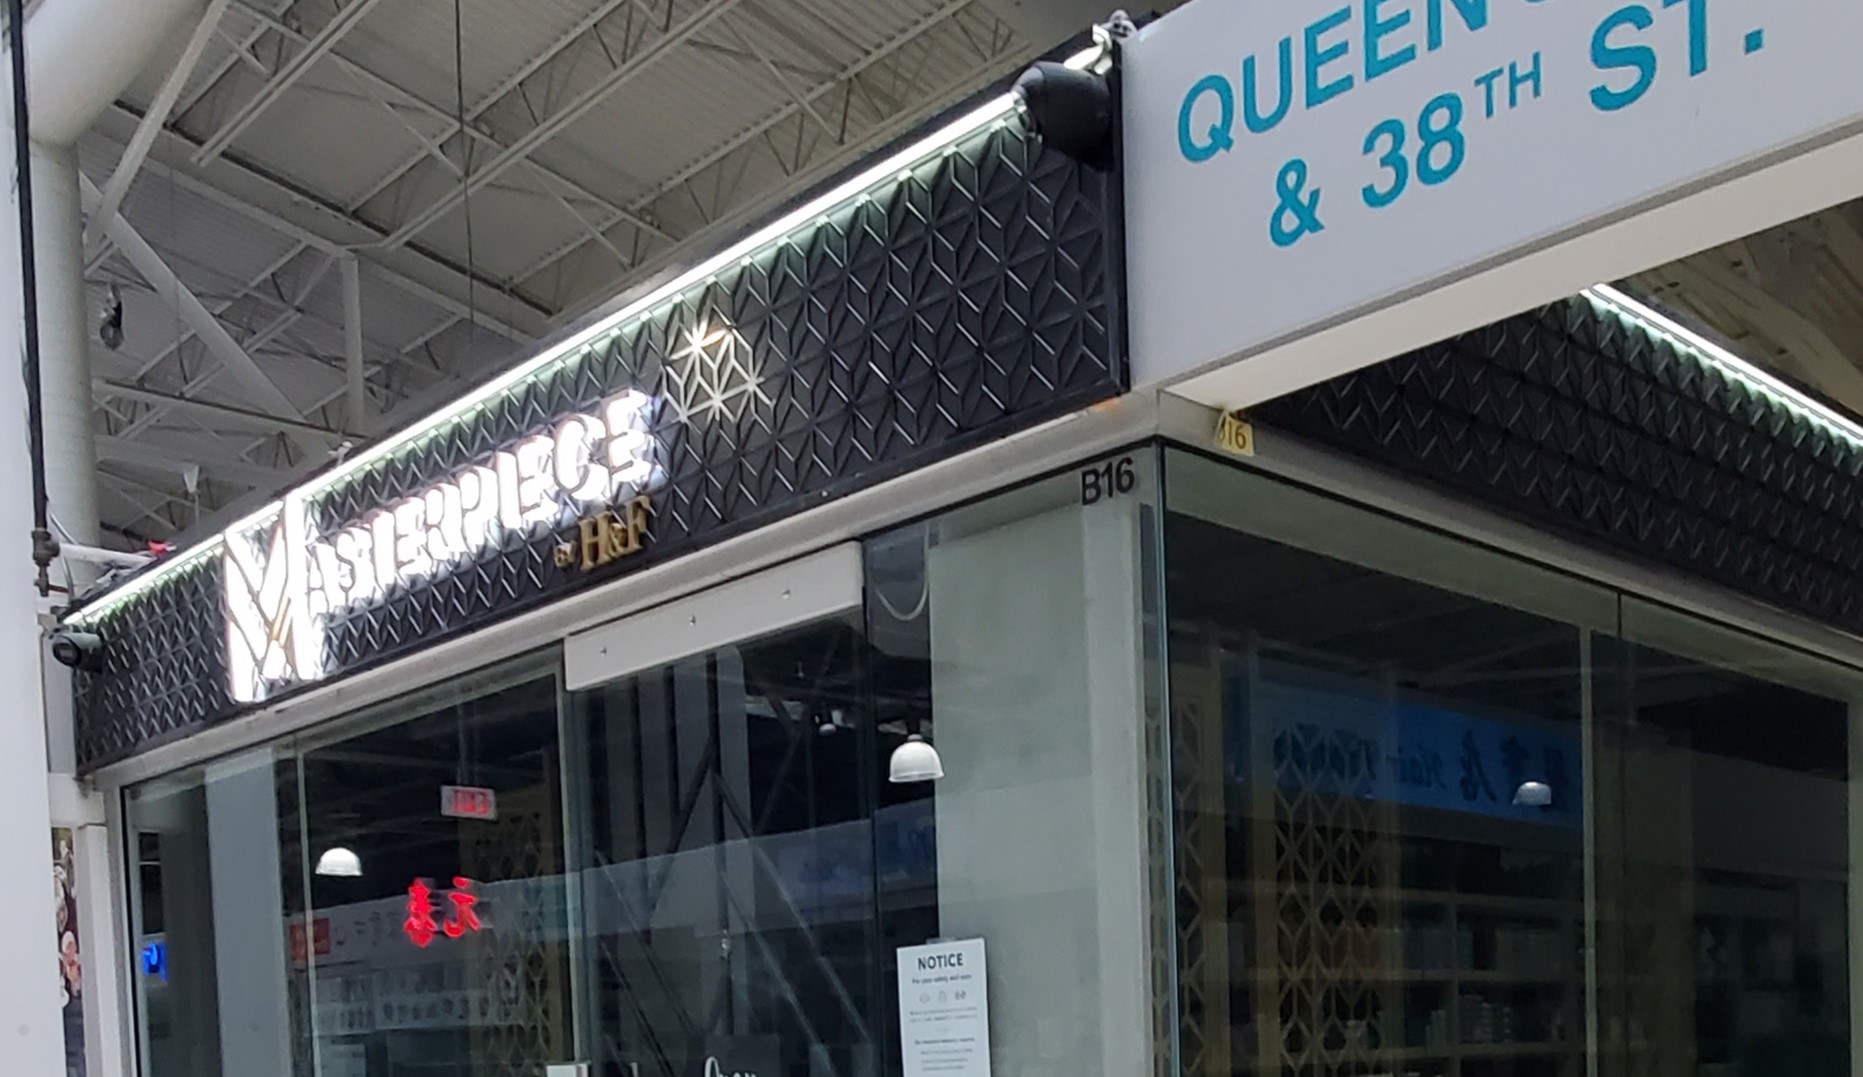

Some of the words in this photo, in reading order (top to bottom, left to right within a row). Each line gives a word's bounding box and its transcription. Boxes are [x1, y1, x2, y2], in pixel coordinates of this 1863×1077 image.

[1178, 0, 1551, 163] QUEEN
[1270, 159, 1325, 248] &
[1590, 0, 1765, 111] ST.
[1081, 457, 1135, 505] B16
[917, 953, 964, 971] NOTICE
